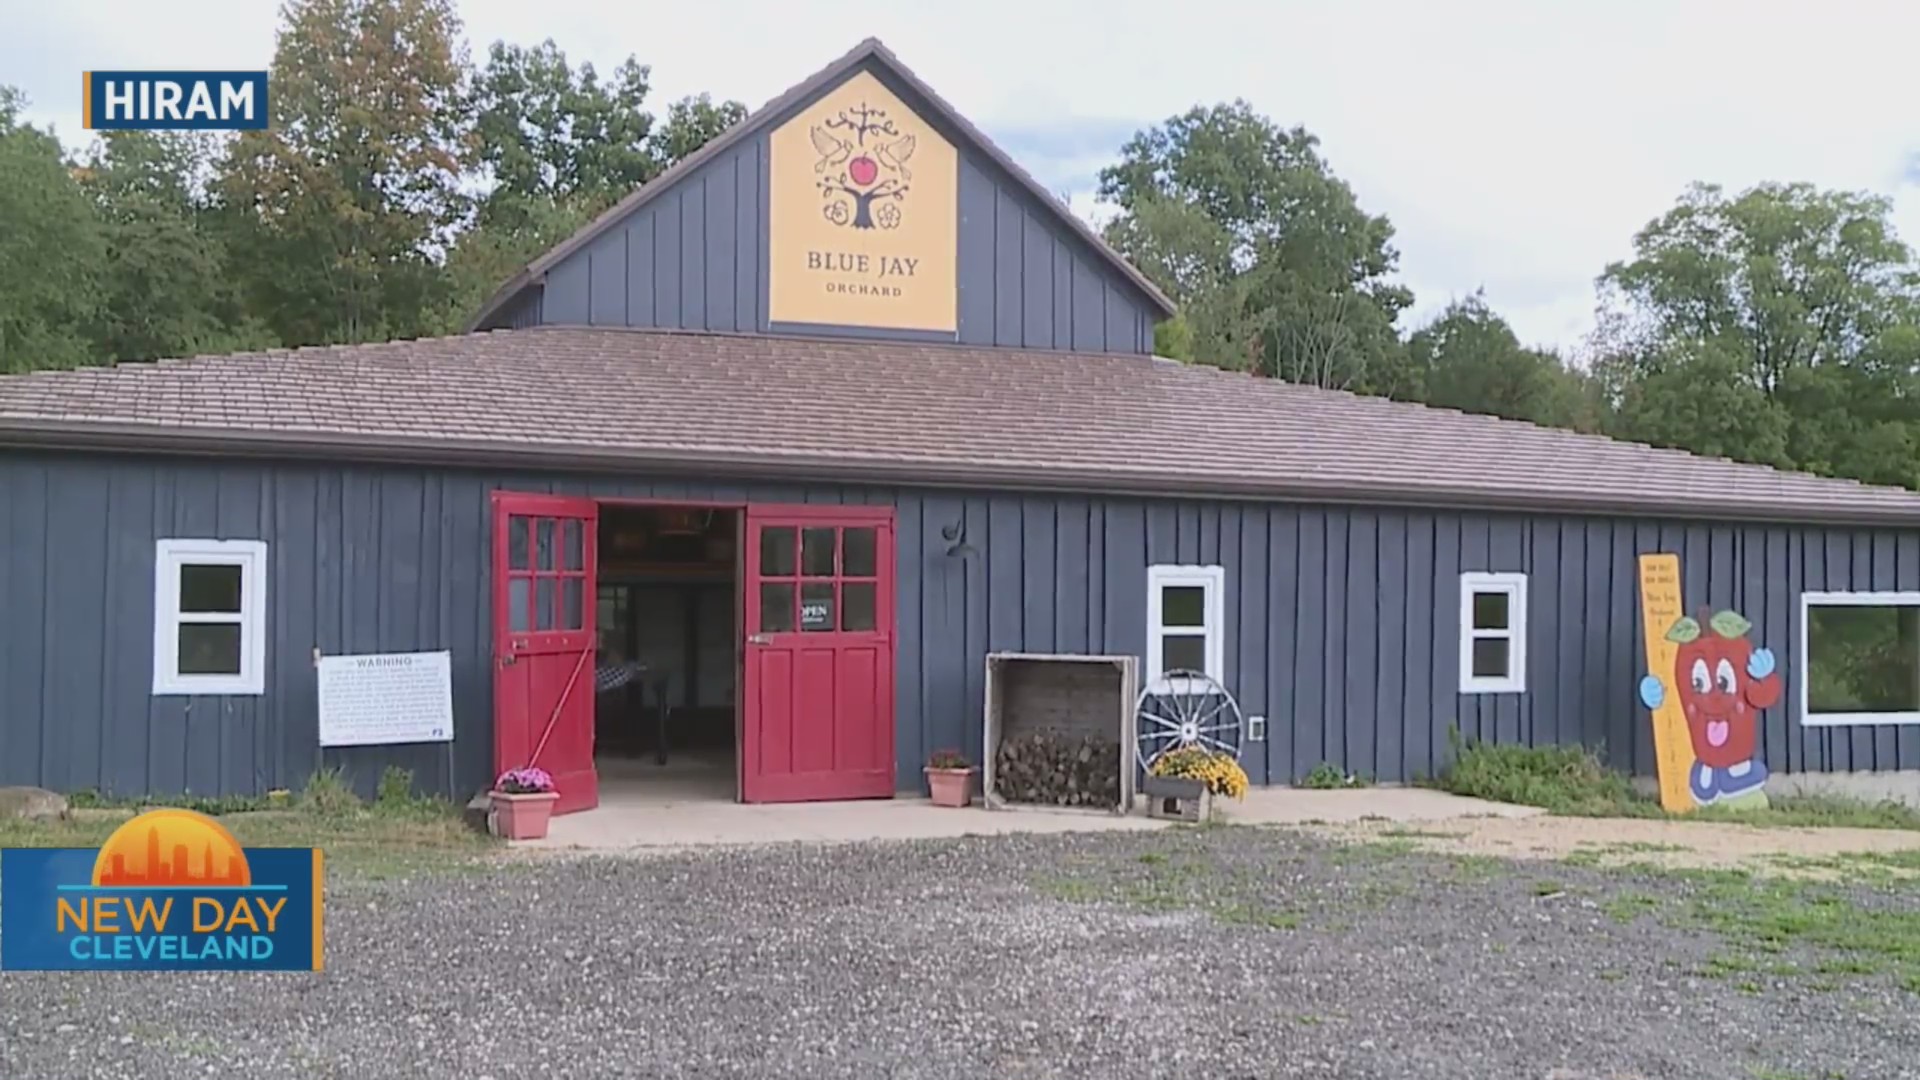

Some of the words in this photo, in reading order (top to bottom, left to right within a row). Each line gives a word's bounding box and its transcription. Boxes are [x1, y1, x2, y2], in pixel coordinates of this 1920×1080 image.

[807, 251, 870, 273] BLUE
[878, 256, 919, 278] JAY
[826, 282, 902, 297] ORCHARD
[356, 656, 413, 668] WARNING
